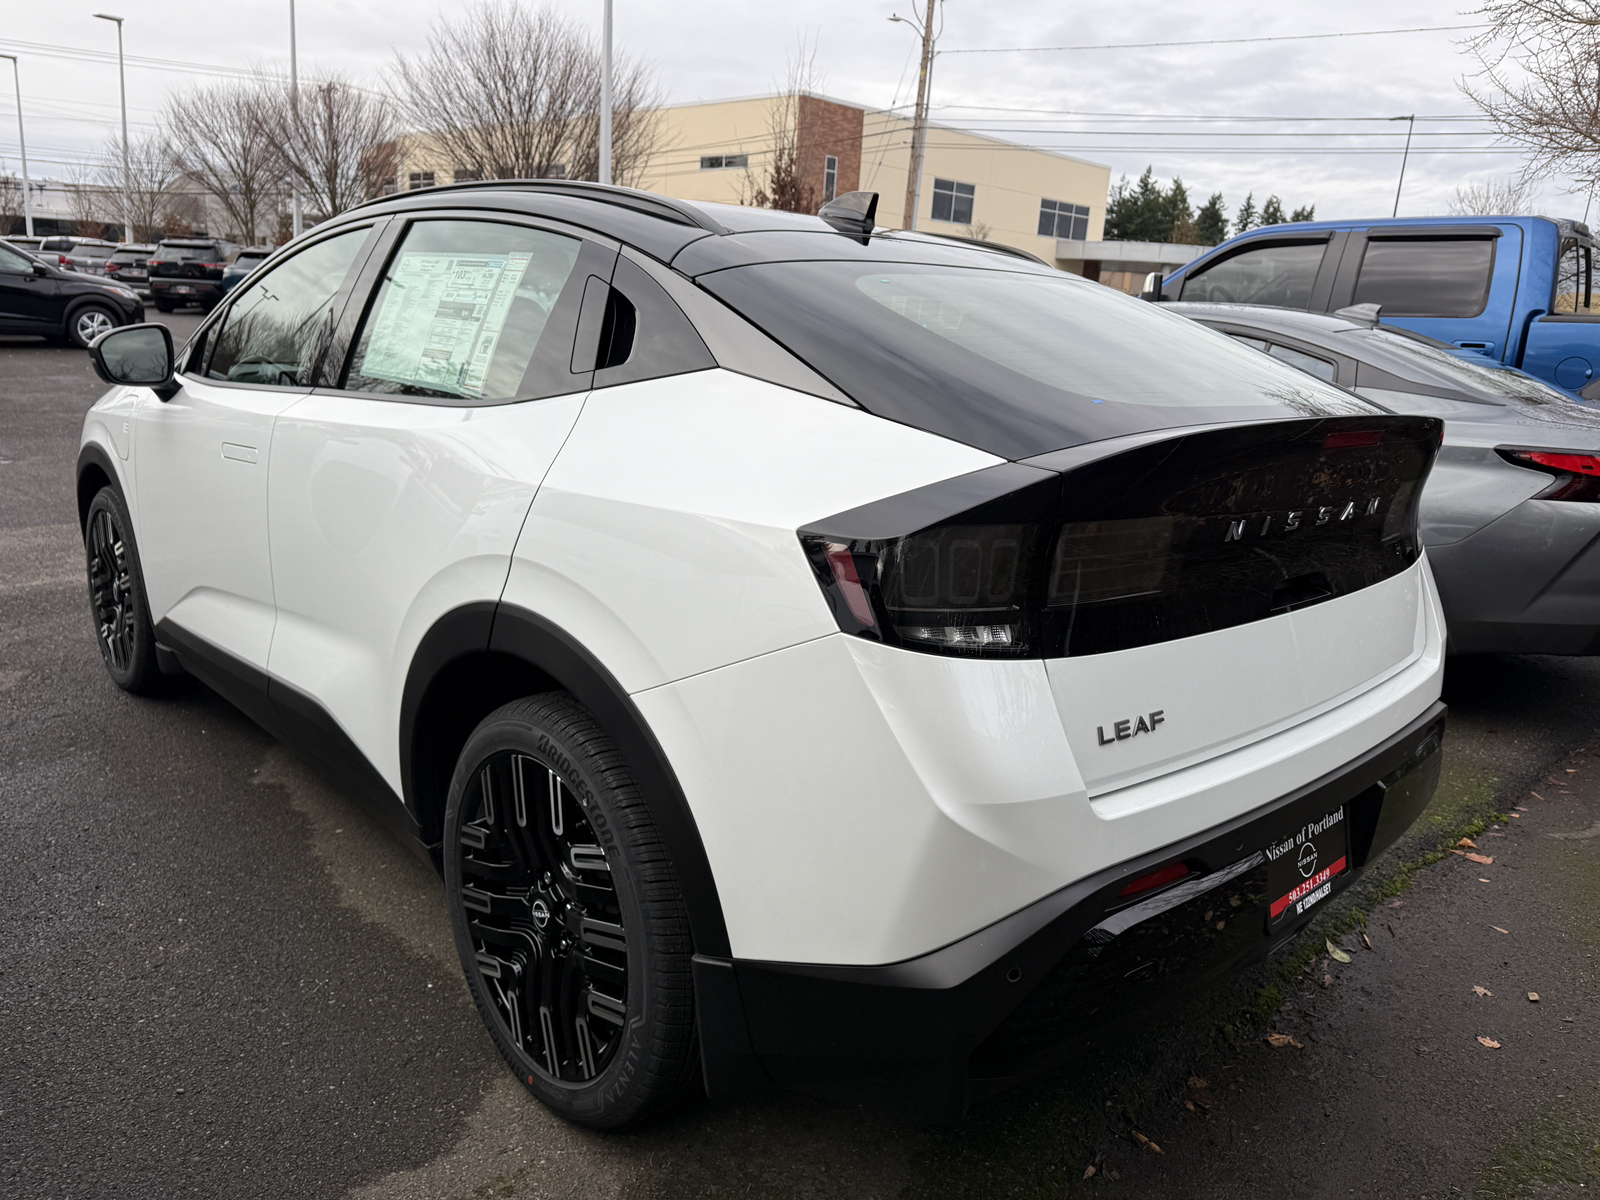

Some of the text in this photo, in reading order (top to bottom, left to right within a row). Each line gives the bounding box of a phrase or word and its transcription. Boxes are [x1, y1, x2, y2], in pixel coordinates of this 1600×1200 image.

[1225, 497, 1380, 542] NISSAN
[1097, 710, 1165, 746] LEAF
[536, 734, 621, 857] BRIDGESTONE
[1296, 826, 1306, 845] of
[1308, 805, 1344, 838] Portland
[1297, 852, 1318, 868] NISSAN
[606, 1034, 642, 1103] ALENZA
